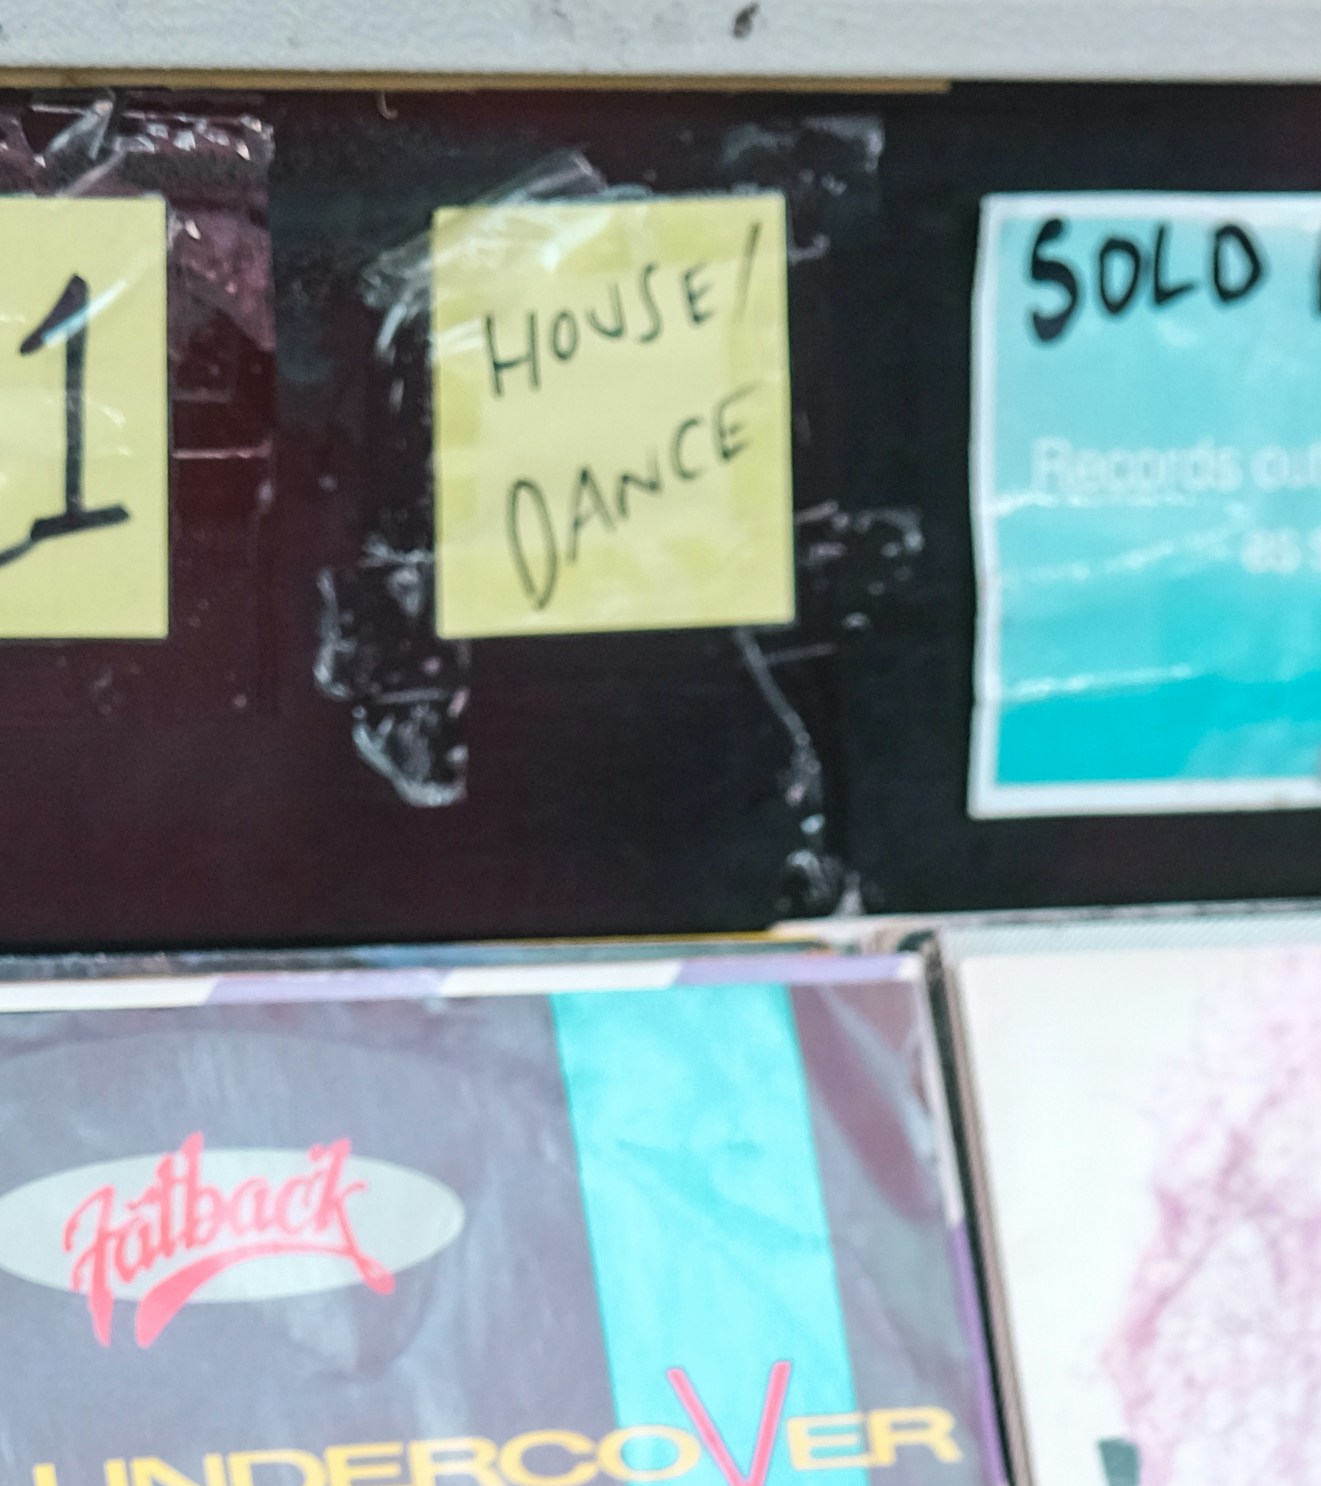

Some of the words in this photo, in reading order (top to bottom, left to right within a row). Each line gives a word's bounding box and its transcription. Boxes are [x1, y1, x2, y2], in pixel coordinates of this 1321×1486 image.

[1028, 217, 1267, 342] SOLD
[0, 273, 131, 565] 1
[506, 383, 760, 611] DANCE
[1032, 436, 1242, 495] Records
[1240, 527, 1300, 574] as
[64, 1132, 395, 1348] Fatback
